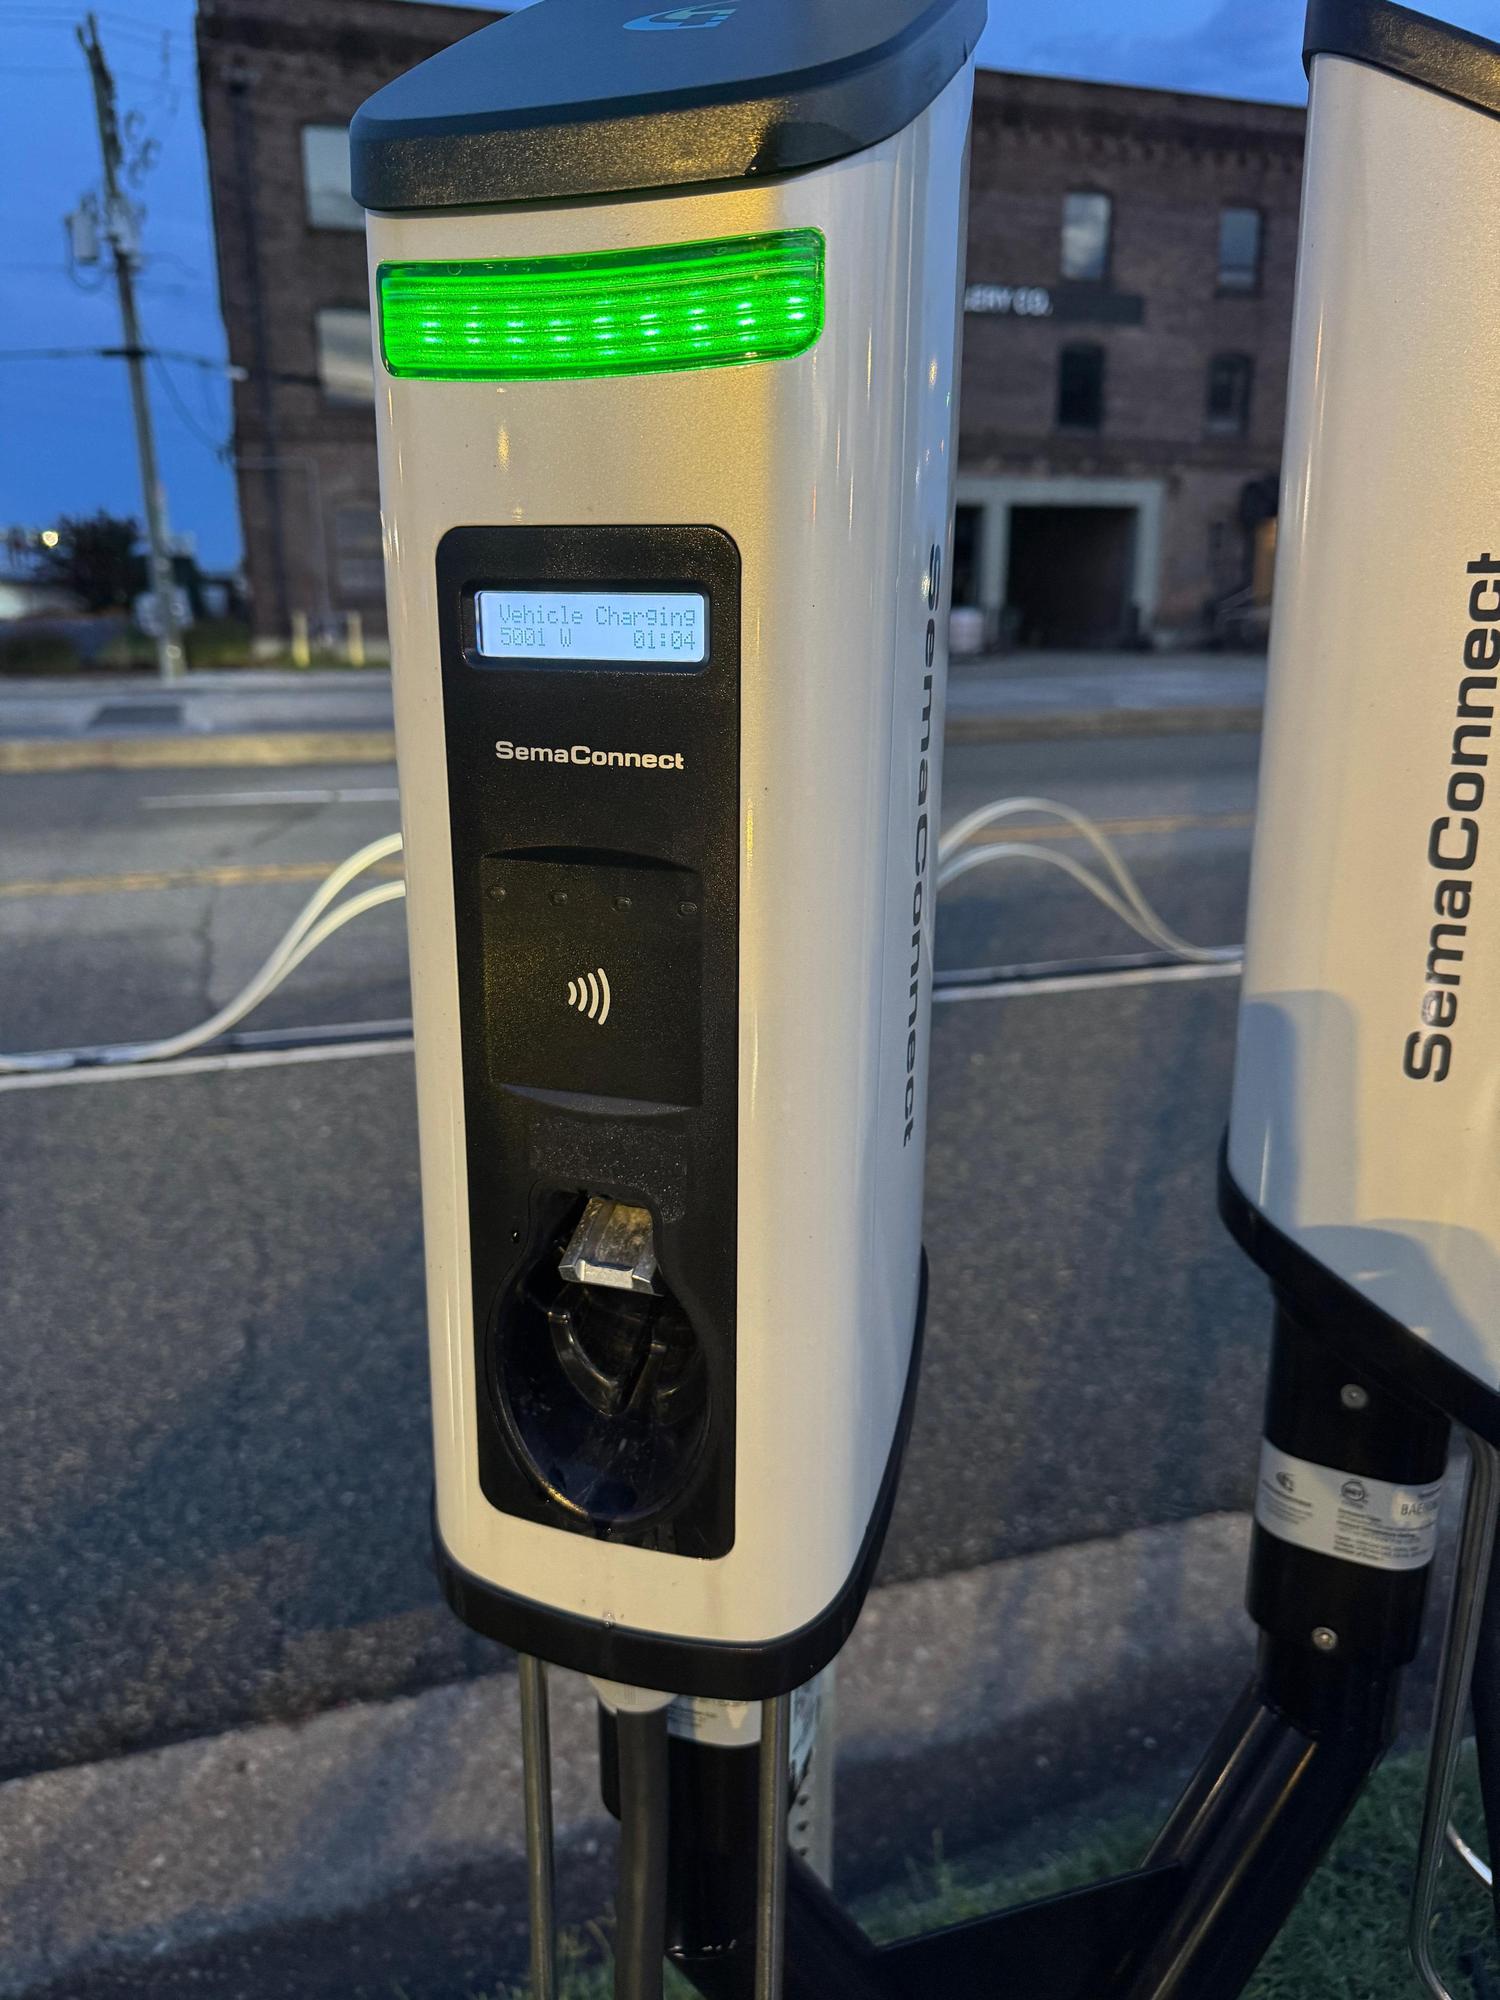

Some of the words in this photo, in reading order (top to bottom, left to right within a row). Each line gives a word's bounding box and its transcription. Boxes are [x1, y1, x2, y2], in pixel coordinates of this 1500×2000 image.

[499, 603, 584, 624] Vehicle
[595, 605, 696, 627] Charging
[500, 626, 546, 647] 5001
[559, 628, 573, 648] W
[632, 629, 696, 650] 01:04
[495, 740, 685, 770] SemaConnect
[1403, 553, 1500, 1082] SemaConnect
[904, 543, 941, 1148] SemaConnect
